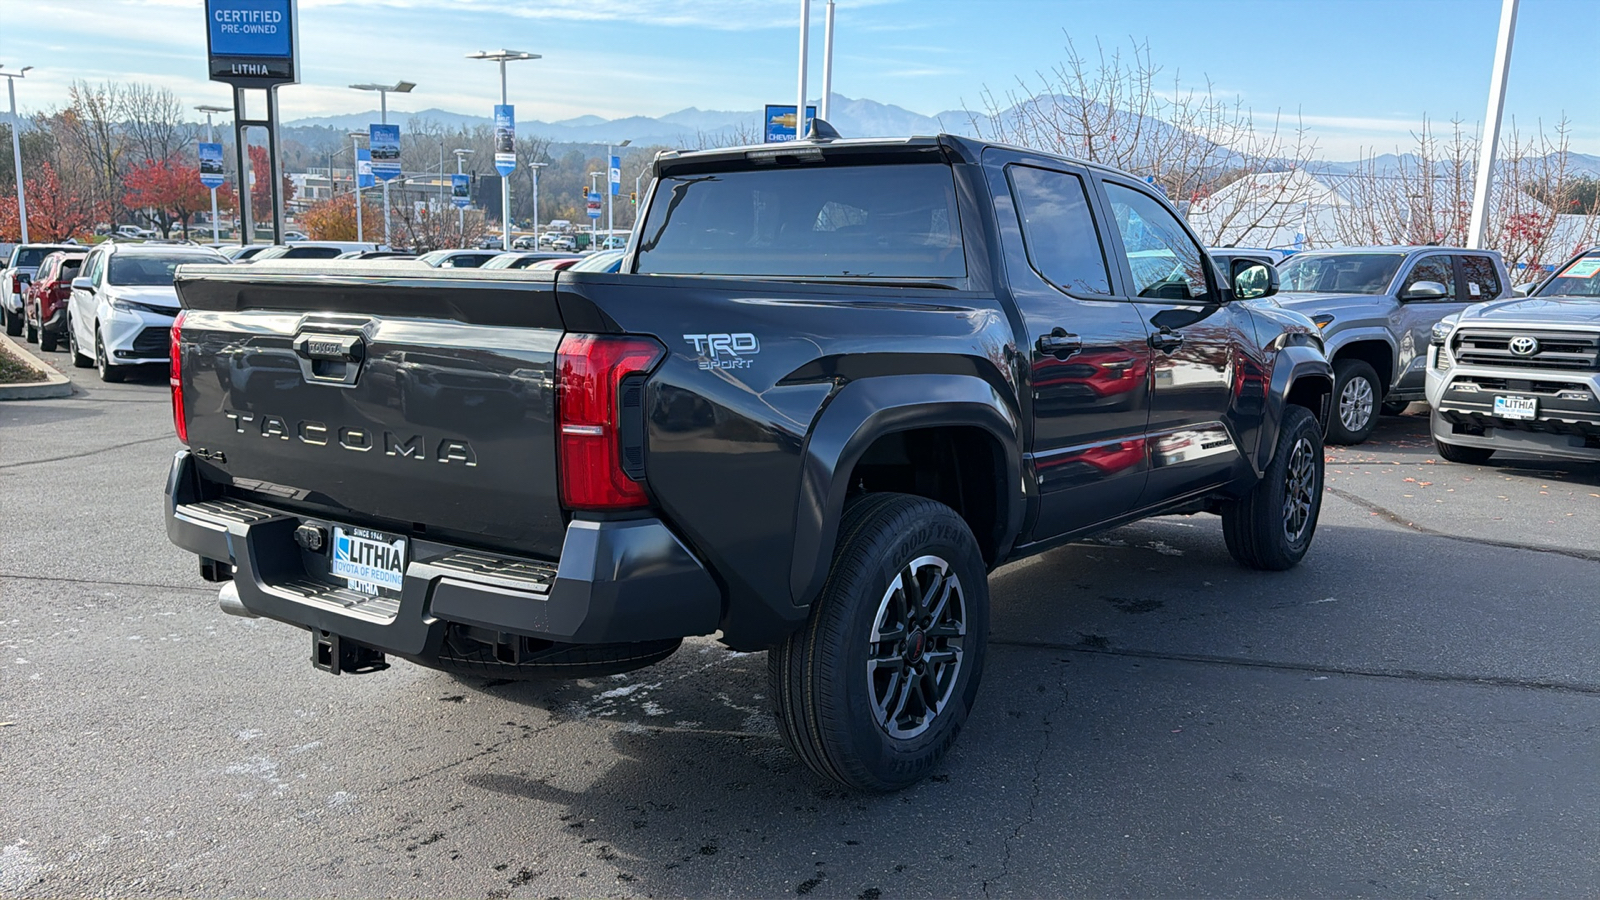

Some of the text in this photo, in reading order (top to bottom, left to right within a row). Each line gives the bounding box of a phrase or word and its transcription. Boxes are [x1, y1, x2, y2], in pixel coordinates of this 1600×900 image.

[215, 10, 282, 23] CERTIFIED
[221, 24, 277, 34] PRE-OWNED
[231, 64, 269, 75] LITHIA
[309, 342, 342, 354] TOYOTA
[683, 333, 757, 357] TRD
[699, 359, 754, 370] SPORT
[1505, 400, 1534, 410] LITHIA
[224, 410, 478, 467] TACOMA
[353, 528, 383, 540] SINCE 1946
[350, 540, 402, 573] LITHIA
[335, 560, 402, 585] TOYOTA OF REDDING
